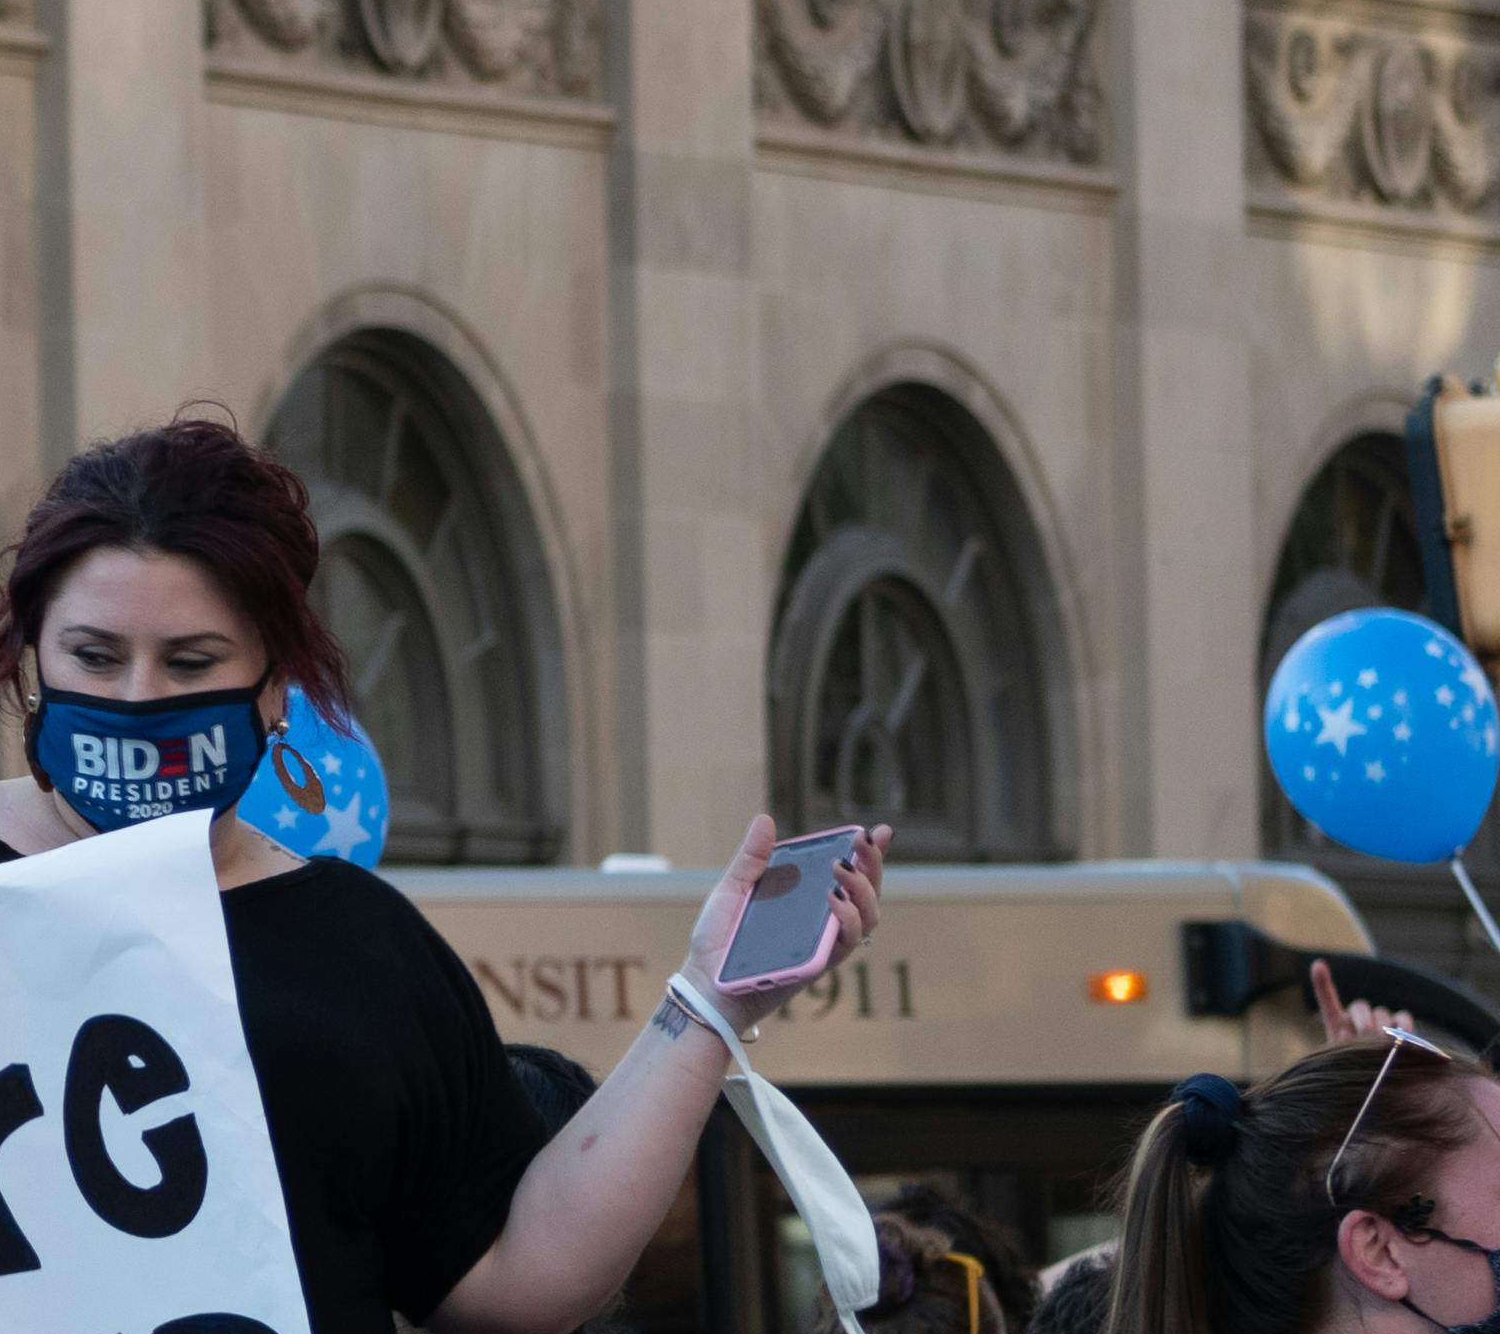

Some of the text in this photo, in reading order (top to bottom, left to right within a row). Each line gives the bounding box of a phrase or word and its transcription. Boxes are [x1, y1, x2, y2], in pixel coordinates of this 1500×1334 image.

[71, 723, 228, 780] BIDEN
[72, 767, 228, 802] PRESIDENT
[127, 801, 174, 819] 2020
[475, 955, 916, 1022] NSIT 911
